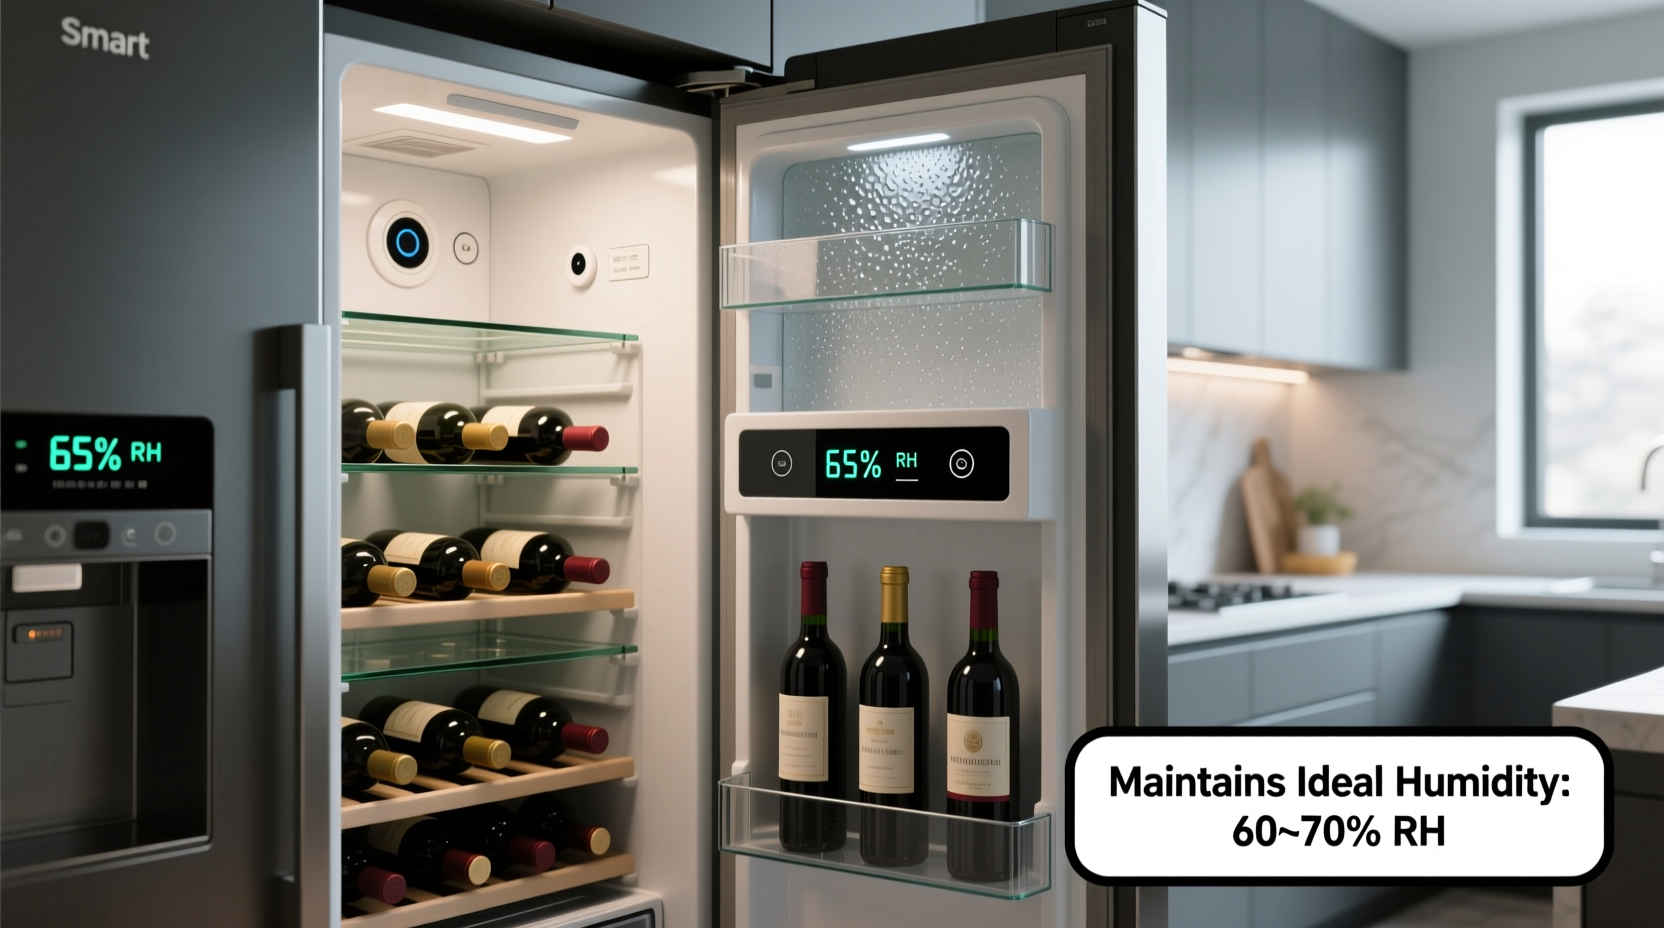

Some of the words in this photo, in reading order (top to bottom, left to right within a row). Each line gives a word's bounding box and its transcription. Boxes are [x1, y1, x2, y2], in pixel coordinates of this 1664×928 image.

[60, 16, 150, 60] Smart
[49, 435, 122, 472] 65%
[130, 441, 162, 463] RH
[825, 449, 882, 479] 65%
[895, 452, 918, 468] RH
